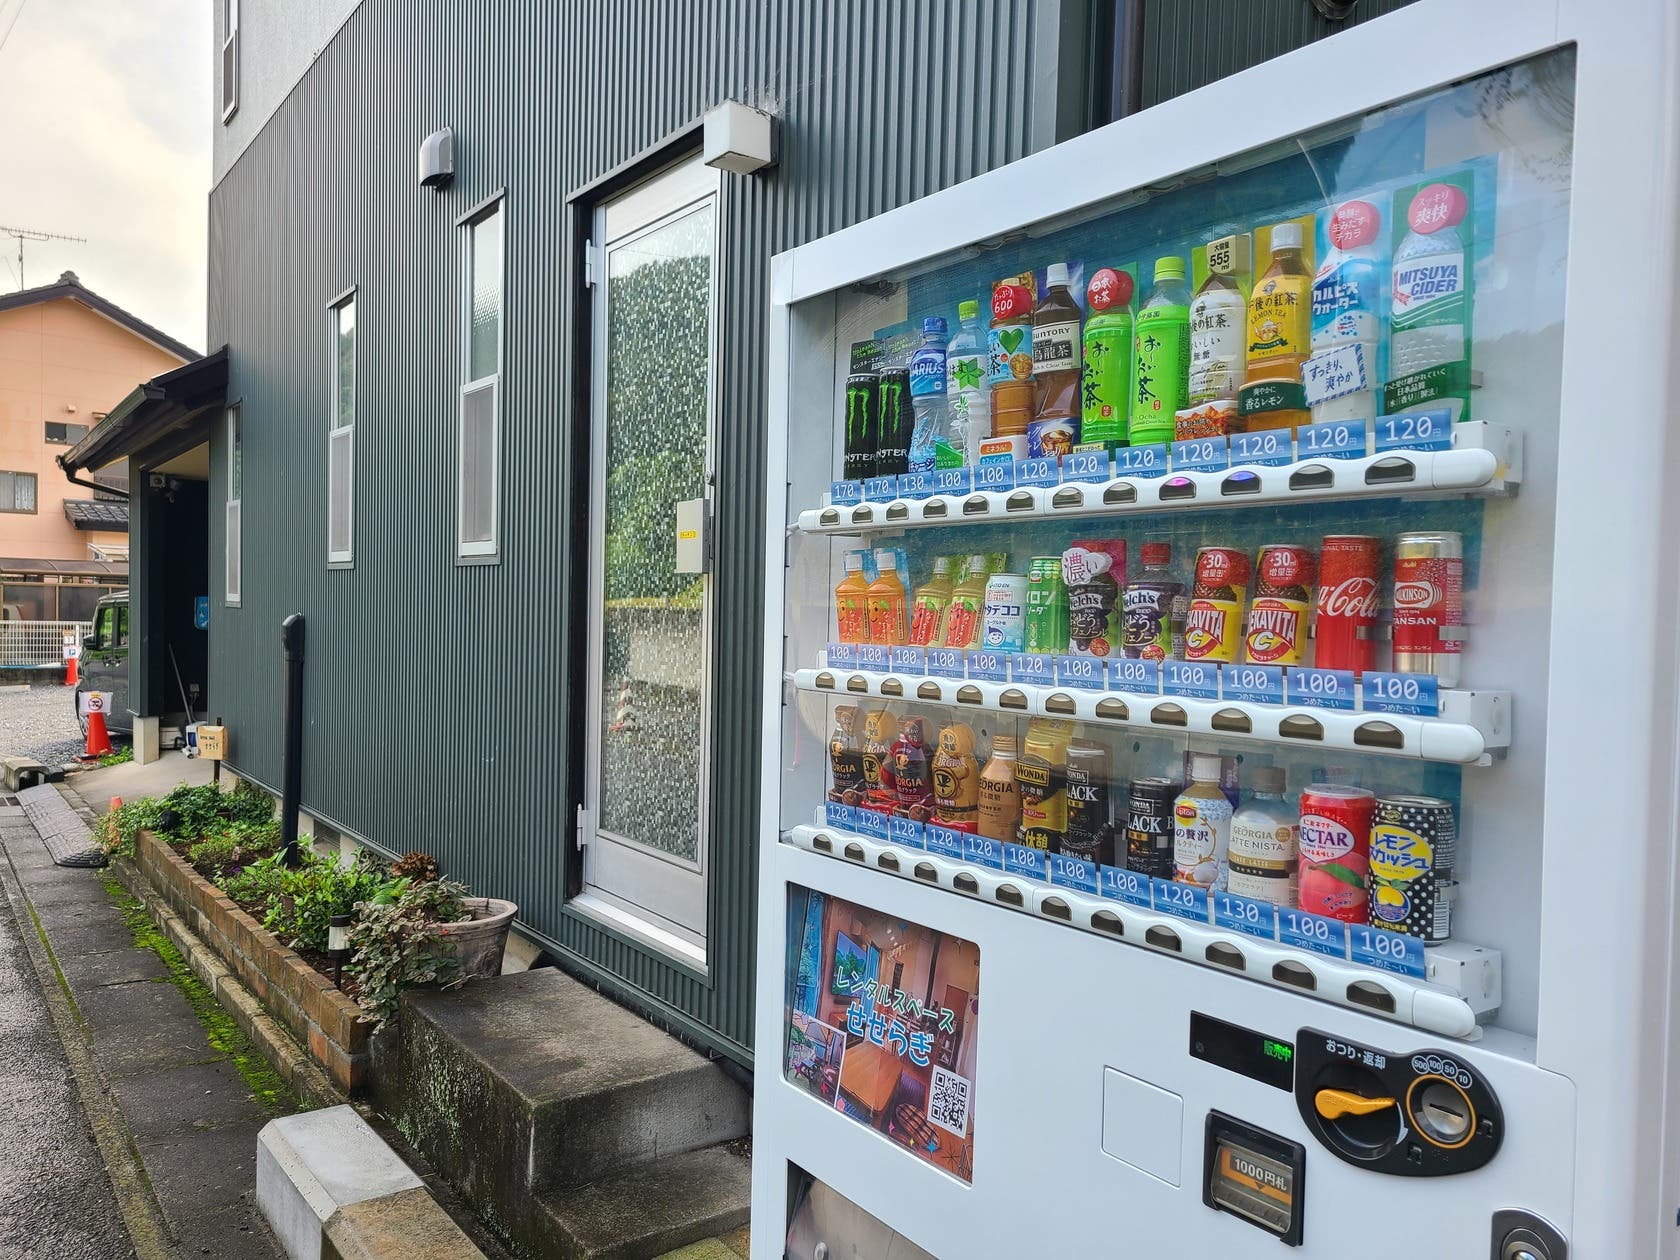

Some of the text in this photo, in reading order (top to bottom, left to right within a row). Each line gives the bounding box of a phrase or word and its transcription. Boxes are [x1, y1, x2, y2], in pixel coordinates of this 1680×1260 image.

[1415, 204, 1448, 226] 爽快
[1209, 251, 1230, 267] 555
[1399, 264, 1458, 285] MITSUYA
[1313, 281, 1359, 302] カルピス
[1411, 279, 1457, 297] CIDER
[994, 300, 1013, 313] 600
[1064, 552, 1098, 584] 濃い
[1070, 594, 1100, 608] elch's
[1188, 629, 1204, 648] C
[1254, 631, 1275, 651] C
[1017, 765, 1046, 781] WONDA
[1375, 831, 1416, 850] レモン
[836, 966, 955, 1034] レンタルスペース
[846, 1001, 935, 1067] せせらぎ
[1264, 1040, 1292, 1063] 販売中
[1325, 1039, 1387, 1070] おつり・返却
[1428, 1060, 1442, 1070] 100
[1444, 1065, 1455, 1074] 50
[1459, 1074, 1468, 1084] 10
[1234, 1158, 1288, 1192] 1000円札
